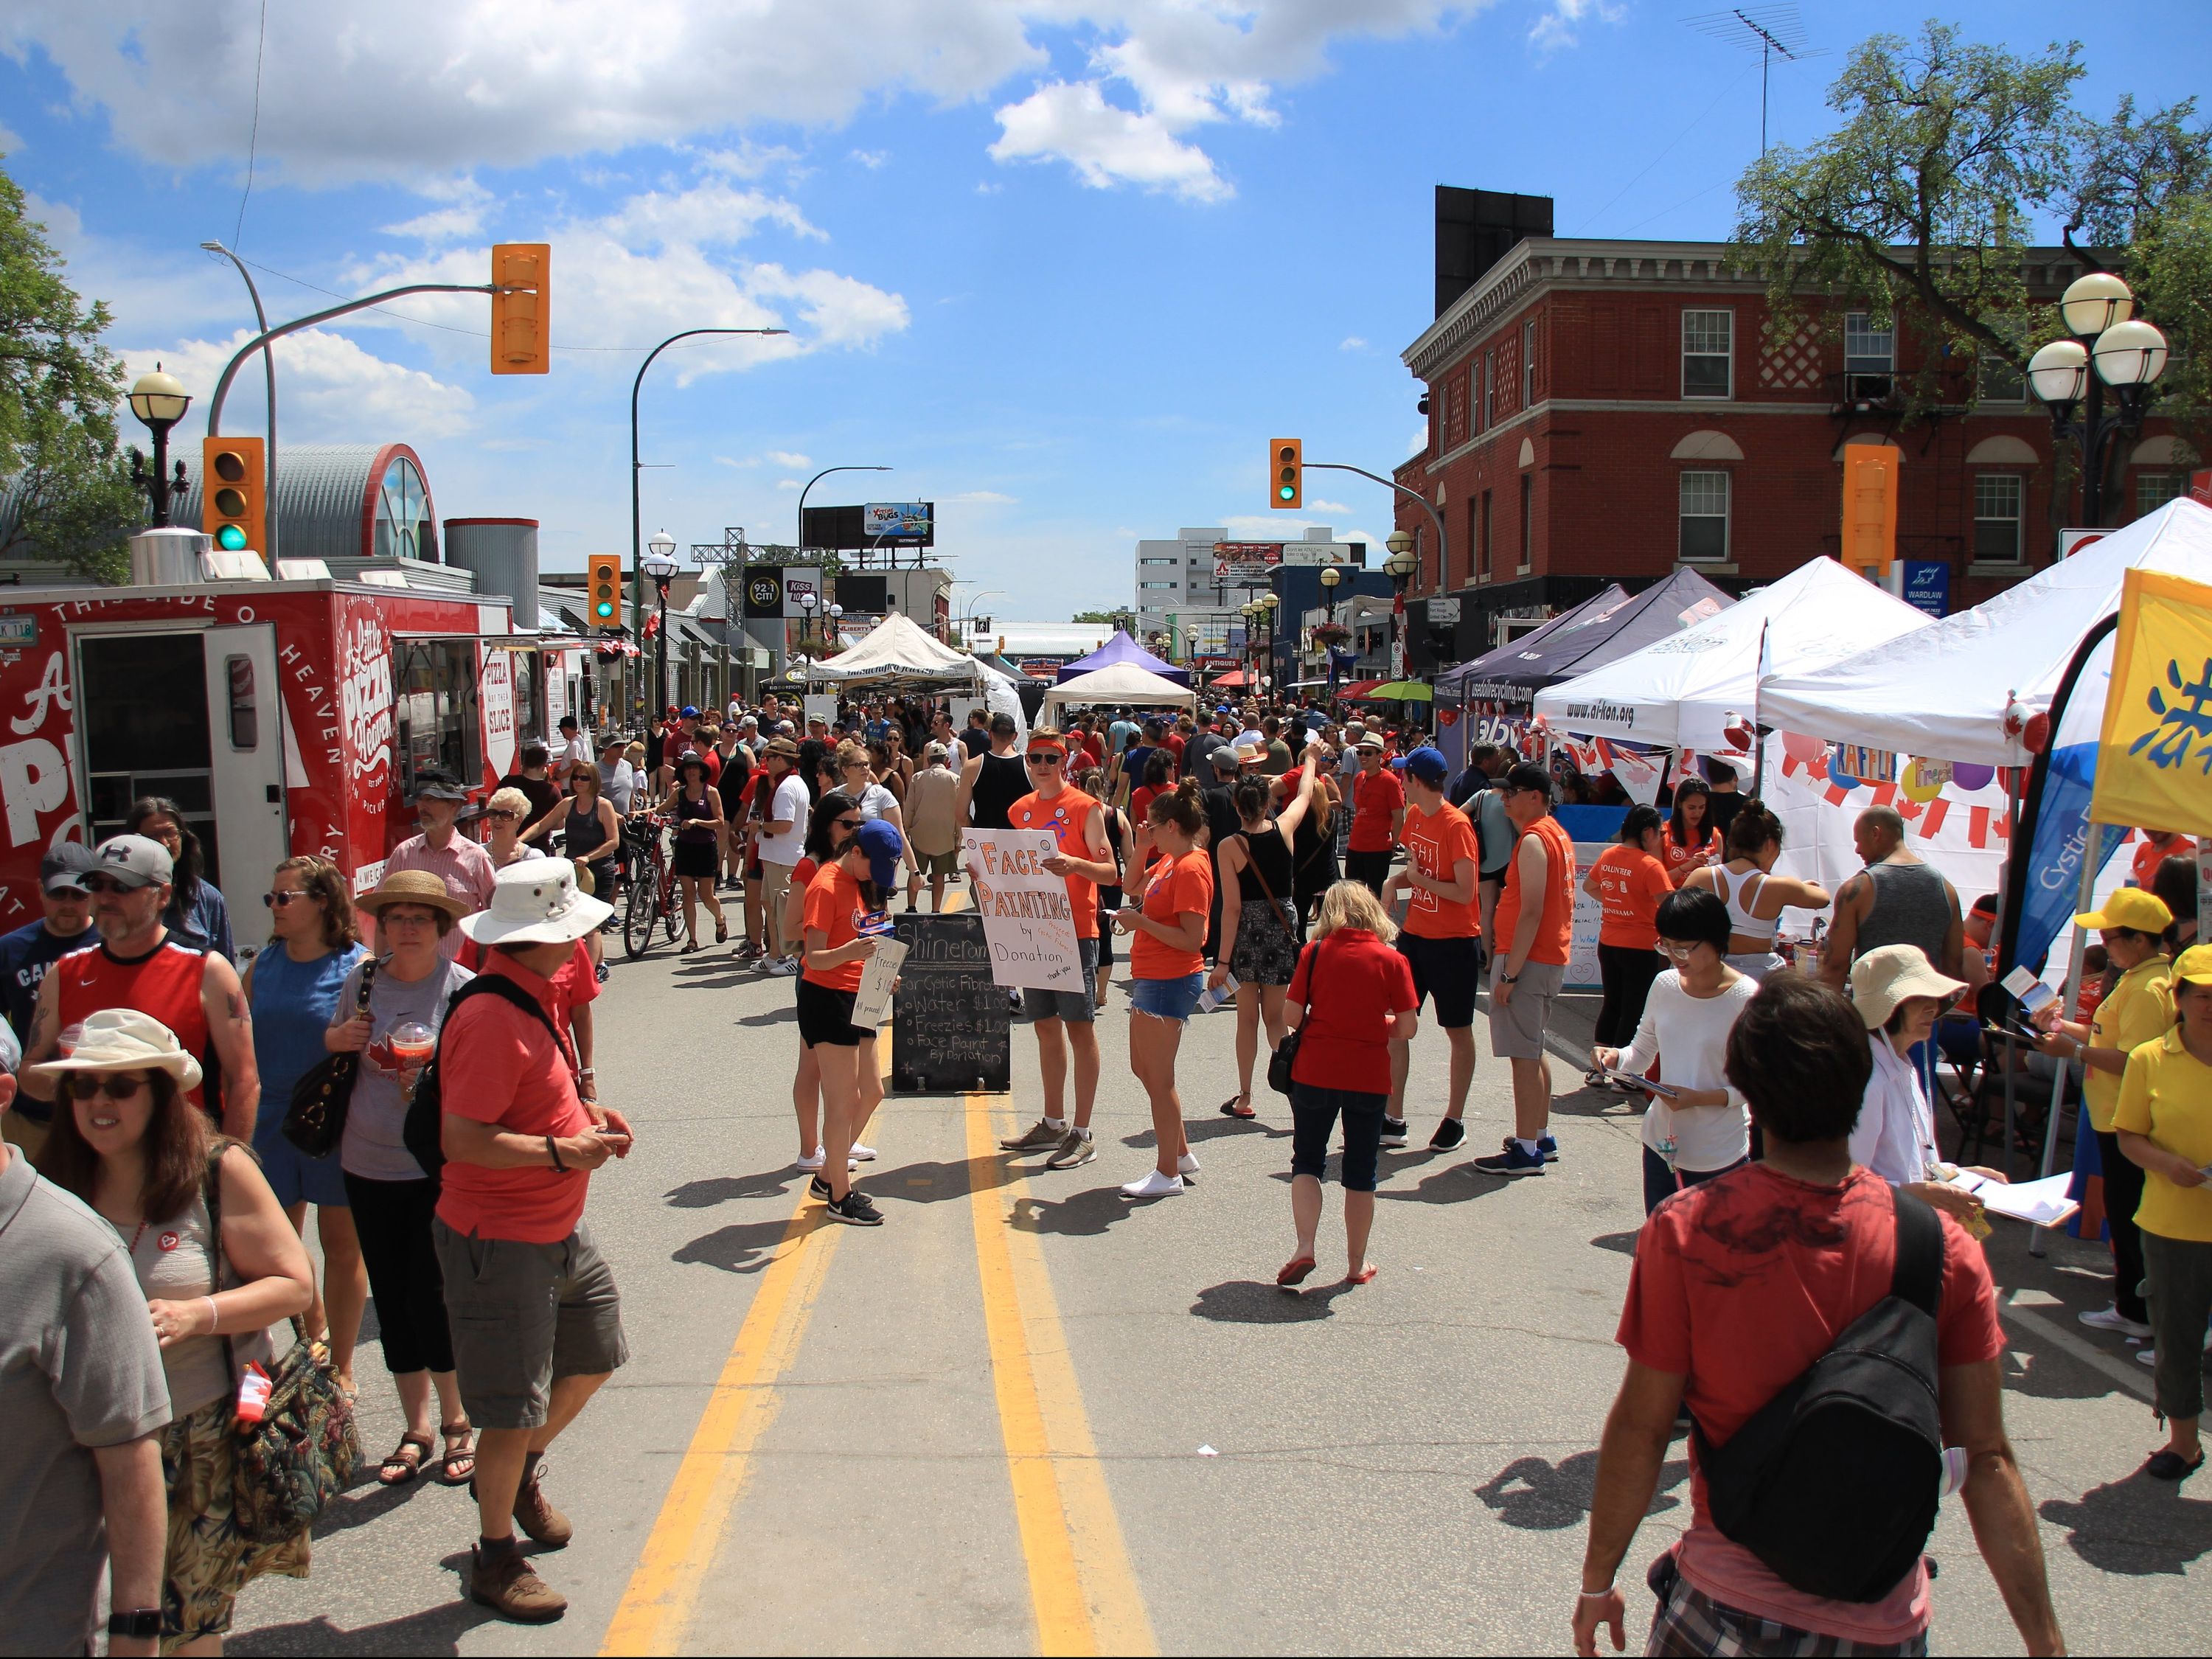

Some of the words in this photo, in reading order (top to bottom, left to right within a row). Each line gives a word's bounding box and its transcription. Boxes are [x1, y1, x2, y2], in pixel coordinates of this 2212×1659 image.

[878, 512, 898, 521] BUGS
[1908, 591, 1942, 599] WARDLAW
[347, 595, 360, 611] THIS
[362, 595, 375, 608] SIDE
[377, 606, 384, 623] OF
[353, 617, 383, 674] Little
[487, 662, 507, 685] PIZZA
[343, 654, 392, 740] PIZZA
[1472, 679, 1532, 704] usedoilrecycling.com
[280, 644, 341, 764] HEAVEN
[1567, 699, 1634, 728] www.ai-kon.org
[490, 709, 510, 734] SLICE
[354, 711, 392, 762] Heaven
[364, 800, 376, 814] PICK
[378, 799, 385, 812] UP
[980, 842, 1043, 875] FACE
[2040, 825, 2089, 889] Cystic
[364, 869, 373, 884] WE
[976, 880, 1071, 920] PAINTING
[1602, 908, 1635, 917] HINERAMA
[898, 923, 989, 959] Shineram
[1020, 922, 1032, 942] by
[994, 942, 1062, 963] Donation
[925, 975, 956, 995] Cystic
[914, 992, 966, 1012] Water
[916, 1015, 973, 1032] Freezies
[951, 1036, 989, 1051] Paint
[931, 1050, 944, 1065] By
[947, 1050, 1001, 1064] Donation
